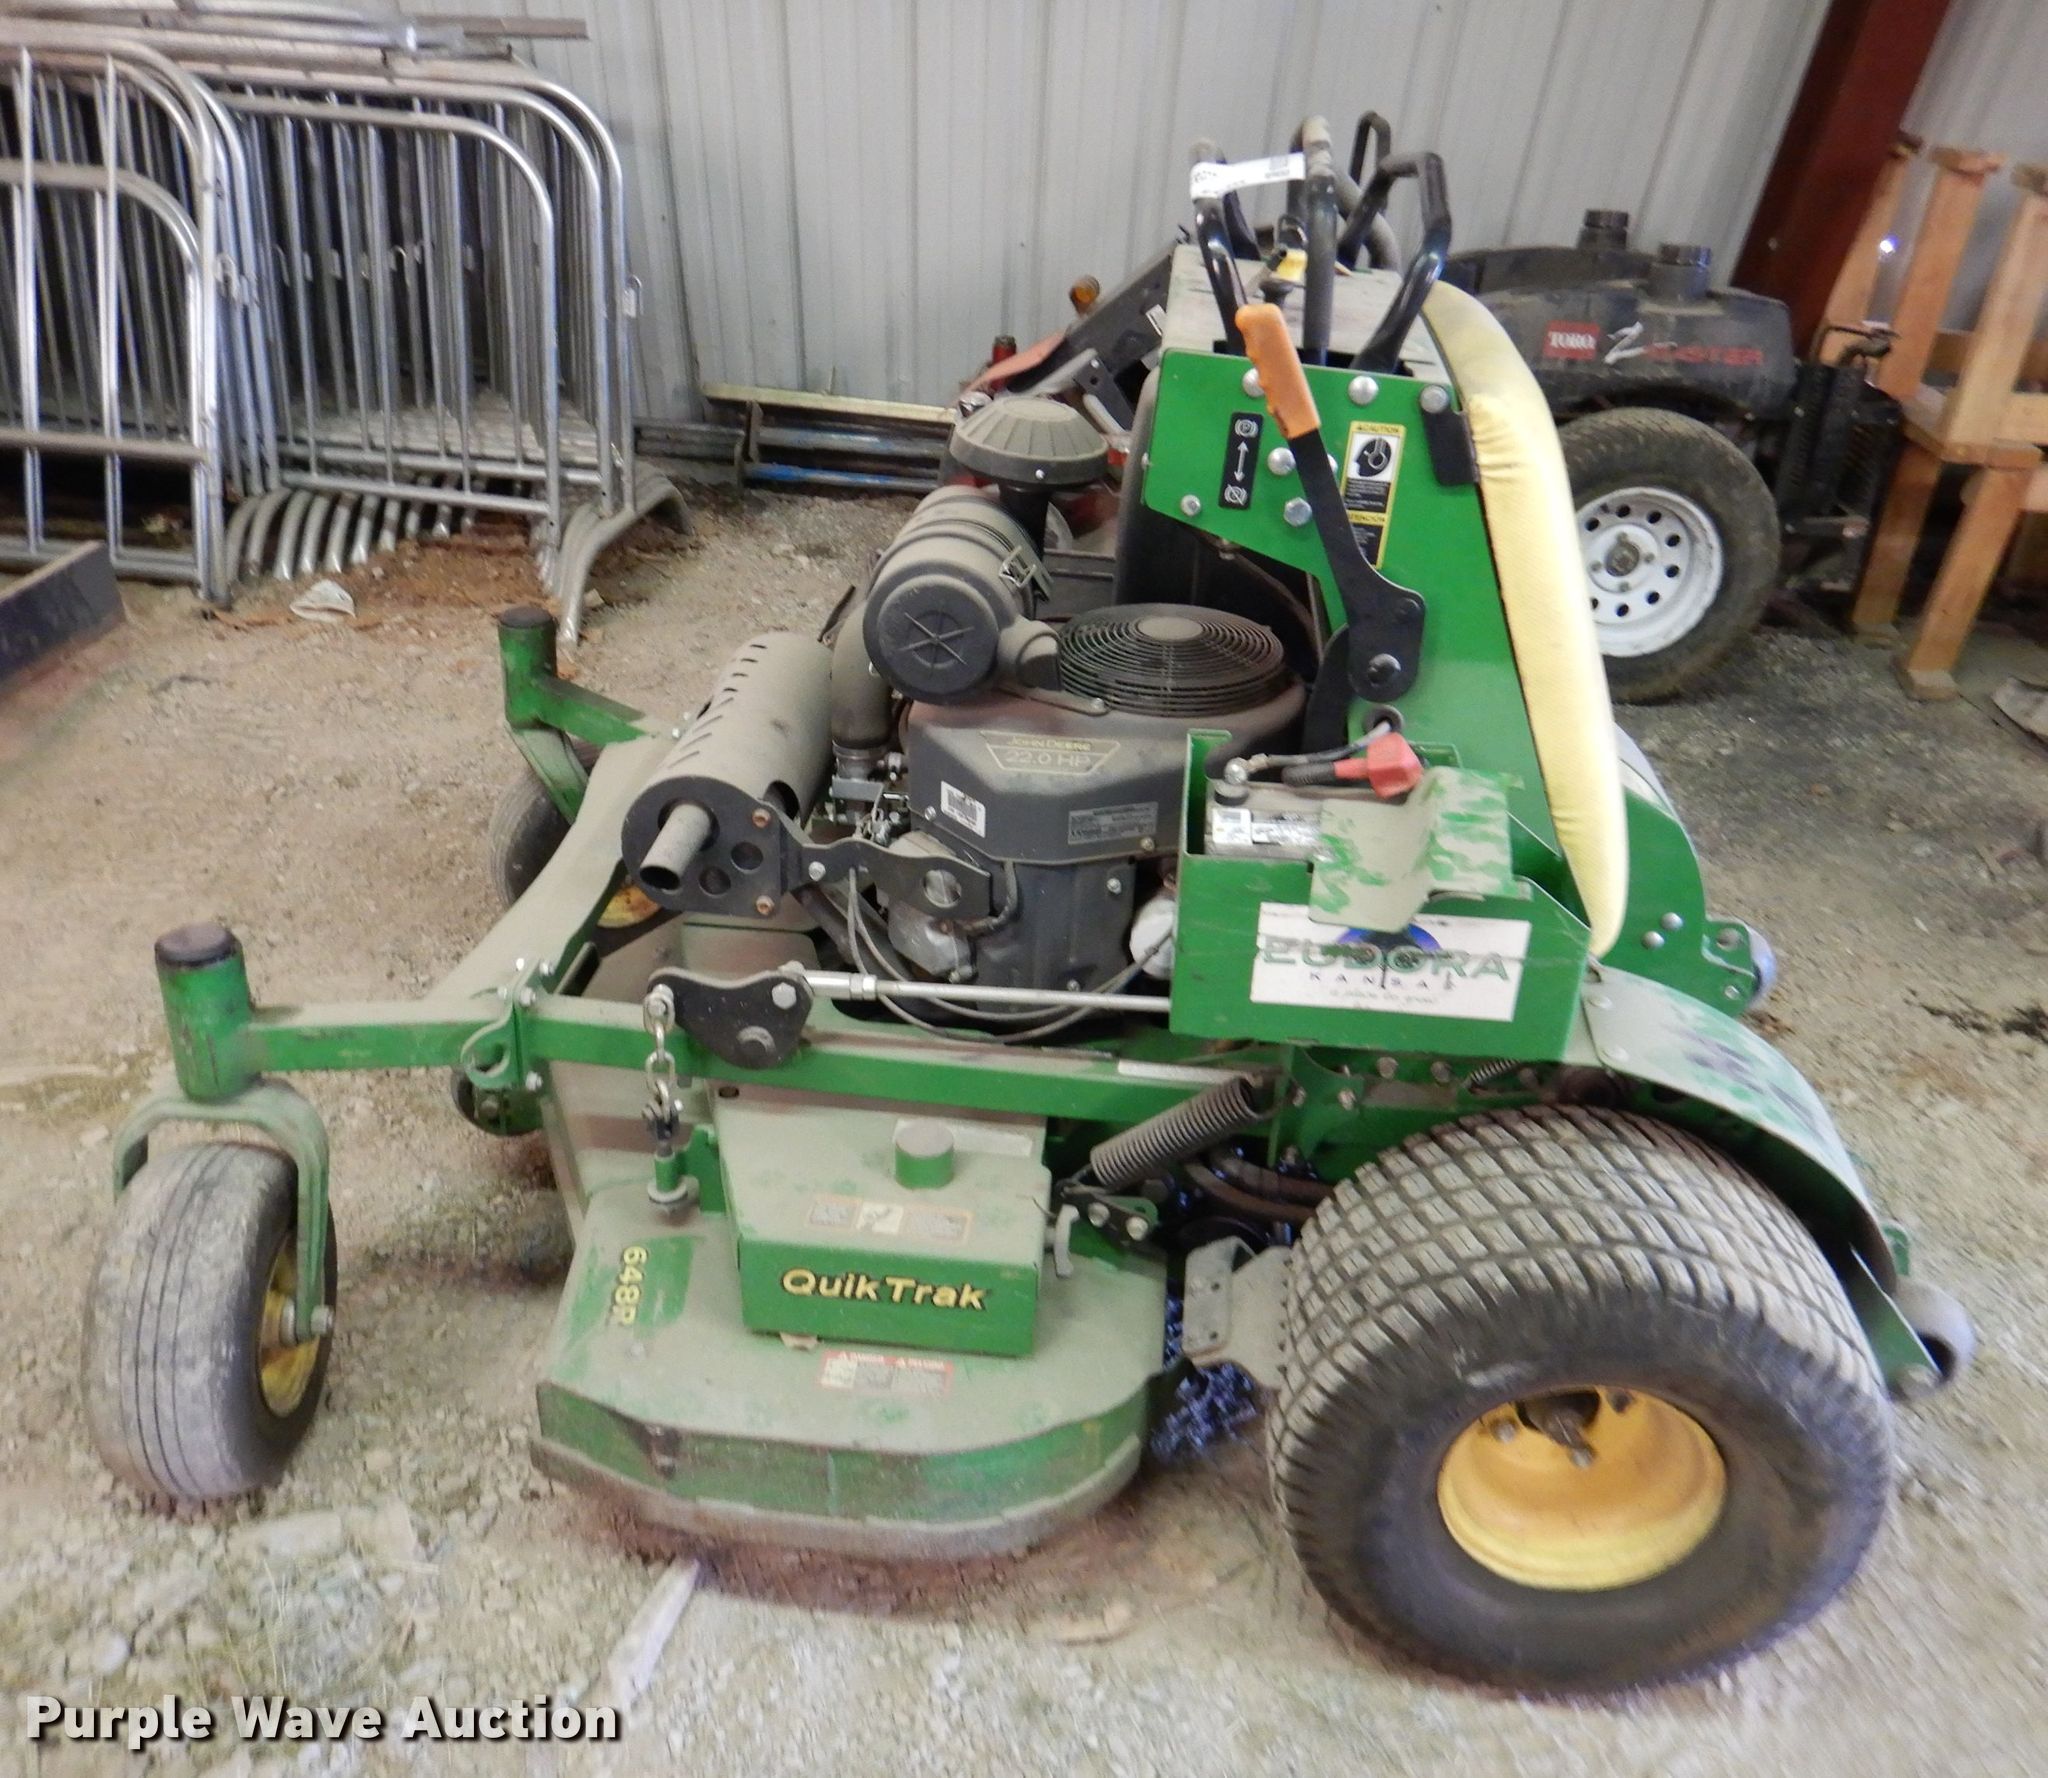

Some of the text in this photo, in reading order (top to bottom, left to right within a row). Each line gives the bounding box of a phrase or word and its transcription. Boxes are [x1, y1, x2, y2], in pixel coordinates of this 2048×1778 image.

[1548, 330, 1598, 350] TORO
[1005, 751, 1092, 767] 22.0 HP
[1261, 934, 1511, 982] EUDORA
[612, 1245, 648, 1326] 648R
[781, 1267, 985, 1311] Quik Trak
